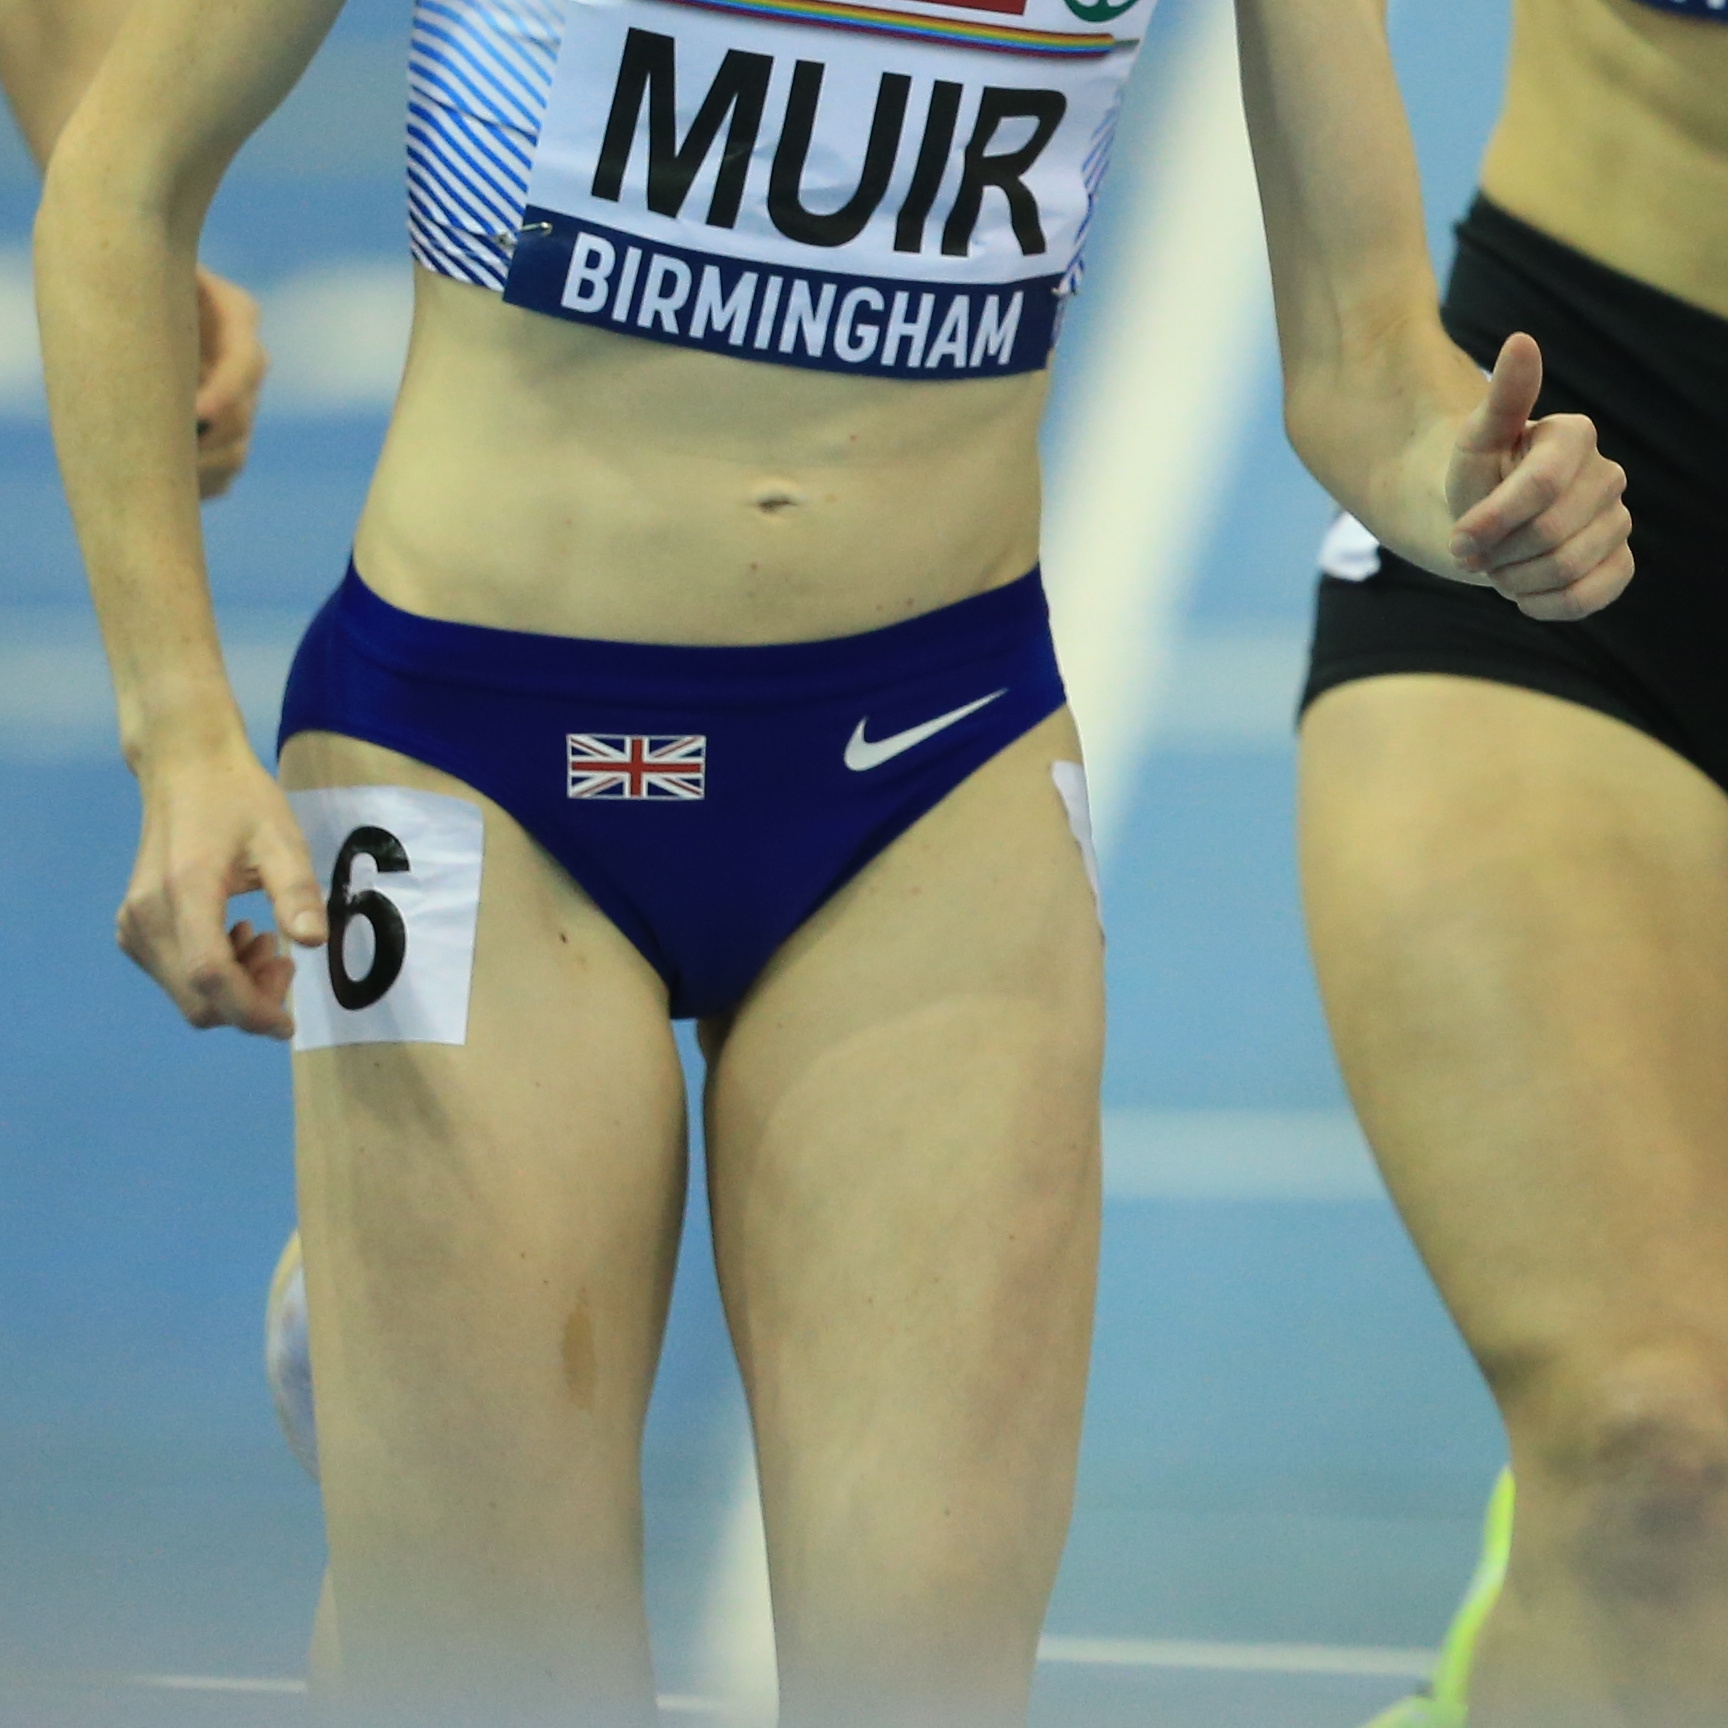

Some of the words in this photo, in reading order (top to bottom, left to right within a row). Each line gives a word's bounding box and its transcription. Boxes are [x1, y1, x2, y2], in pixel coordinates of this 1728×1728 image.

[590, 27, 1068, 257] MUIR
[560, 232, 1025, 370] BIRMINGHAM
[326, 824, 410, 1011] 6
